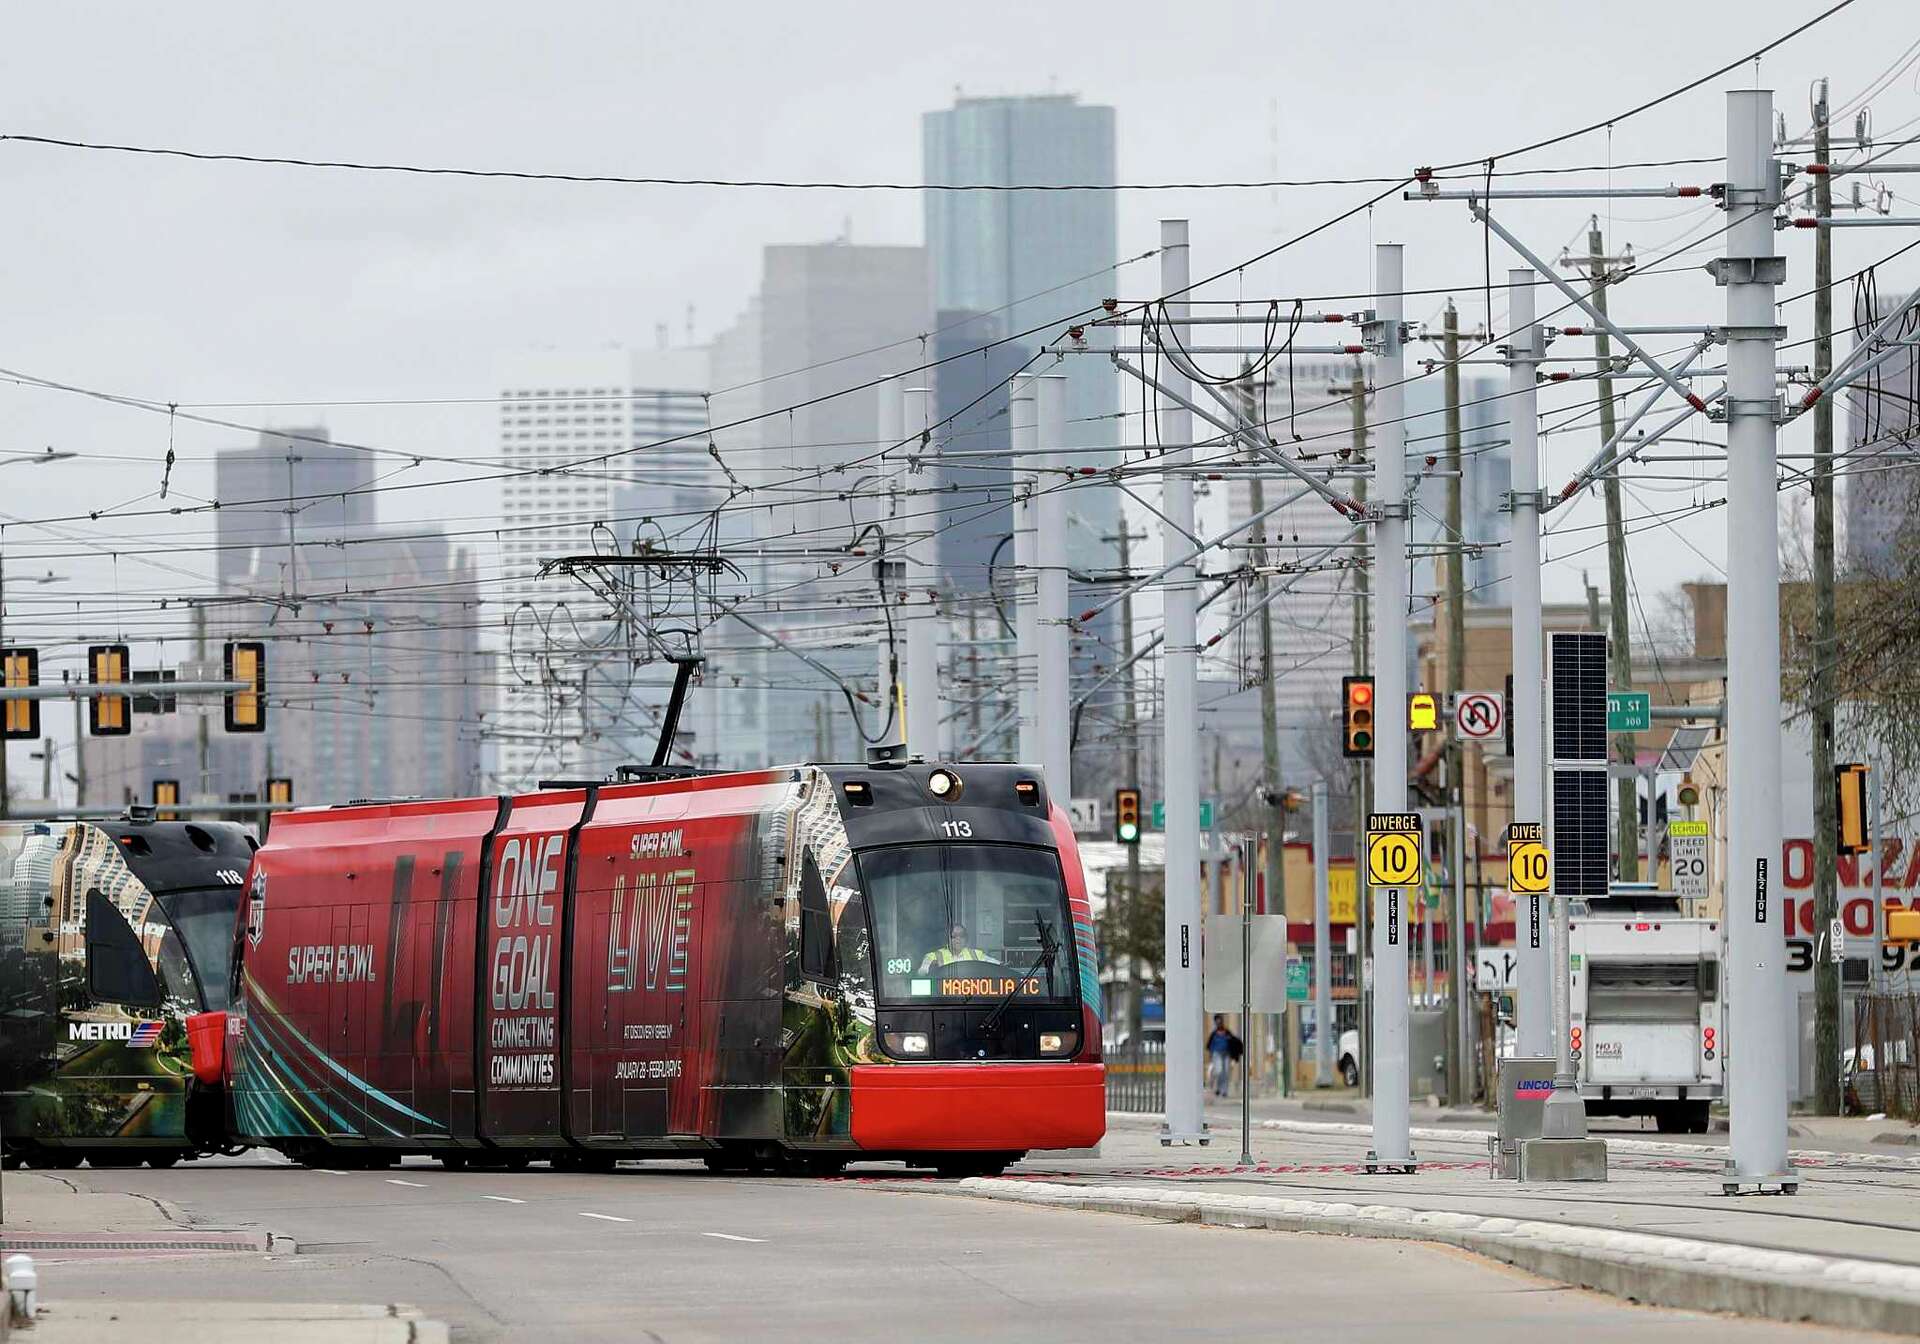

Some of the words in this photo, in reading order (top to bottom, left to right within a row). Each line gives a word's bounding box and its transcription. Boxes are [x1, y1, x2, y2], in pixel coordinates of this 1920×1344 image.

[1627, 700, 1640, 712] ST
[941, 820, 973, 837] 113
[1370, 815, 1417, 830] DIVERGE
[1672, 826, 1704, 834] SCHOOL
[629, 831, 660, 860] SUPER
[659, 828, 684, 858] BOWL
[1673, 838, 1704, 847] SPEED
[1381, 845, 1407, 873] 10
[1676, 848, 1701, 857] LIMIT
[1522, 854, 1548, 880] 10
[1675, 859, 1705, 876] 20
[216, 870, 244, 885] 118
[495, 835, 563, 928] ONE
[607, 868, 696, 991] LIVE
[287, 945, 334, 984] SUPER
[336, 944, 376, 983] BOWL
[492, 935, 555, 1010] GOAL
[887, 958, 912, 974] 890
[942, 978, 1015, 996] MAGNOLIA
[69, 1022, 132, 1040] METRO
[491, 1016, 554, 1048] CONNECTING
[491, 1053, 554, 1085] COMMUNITIES
